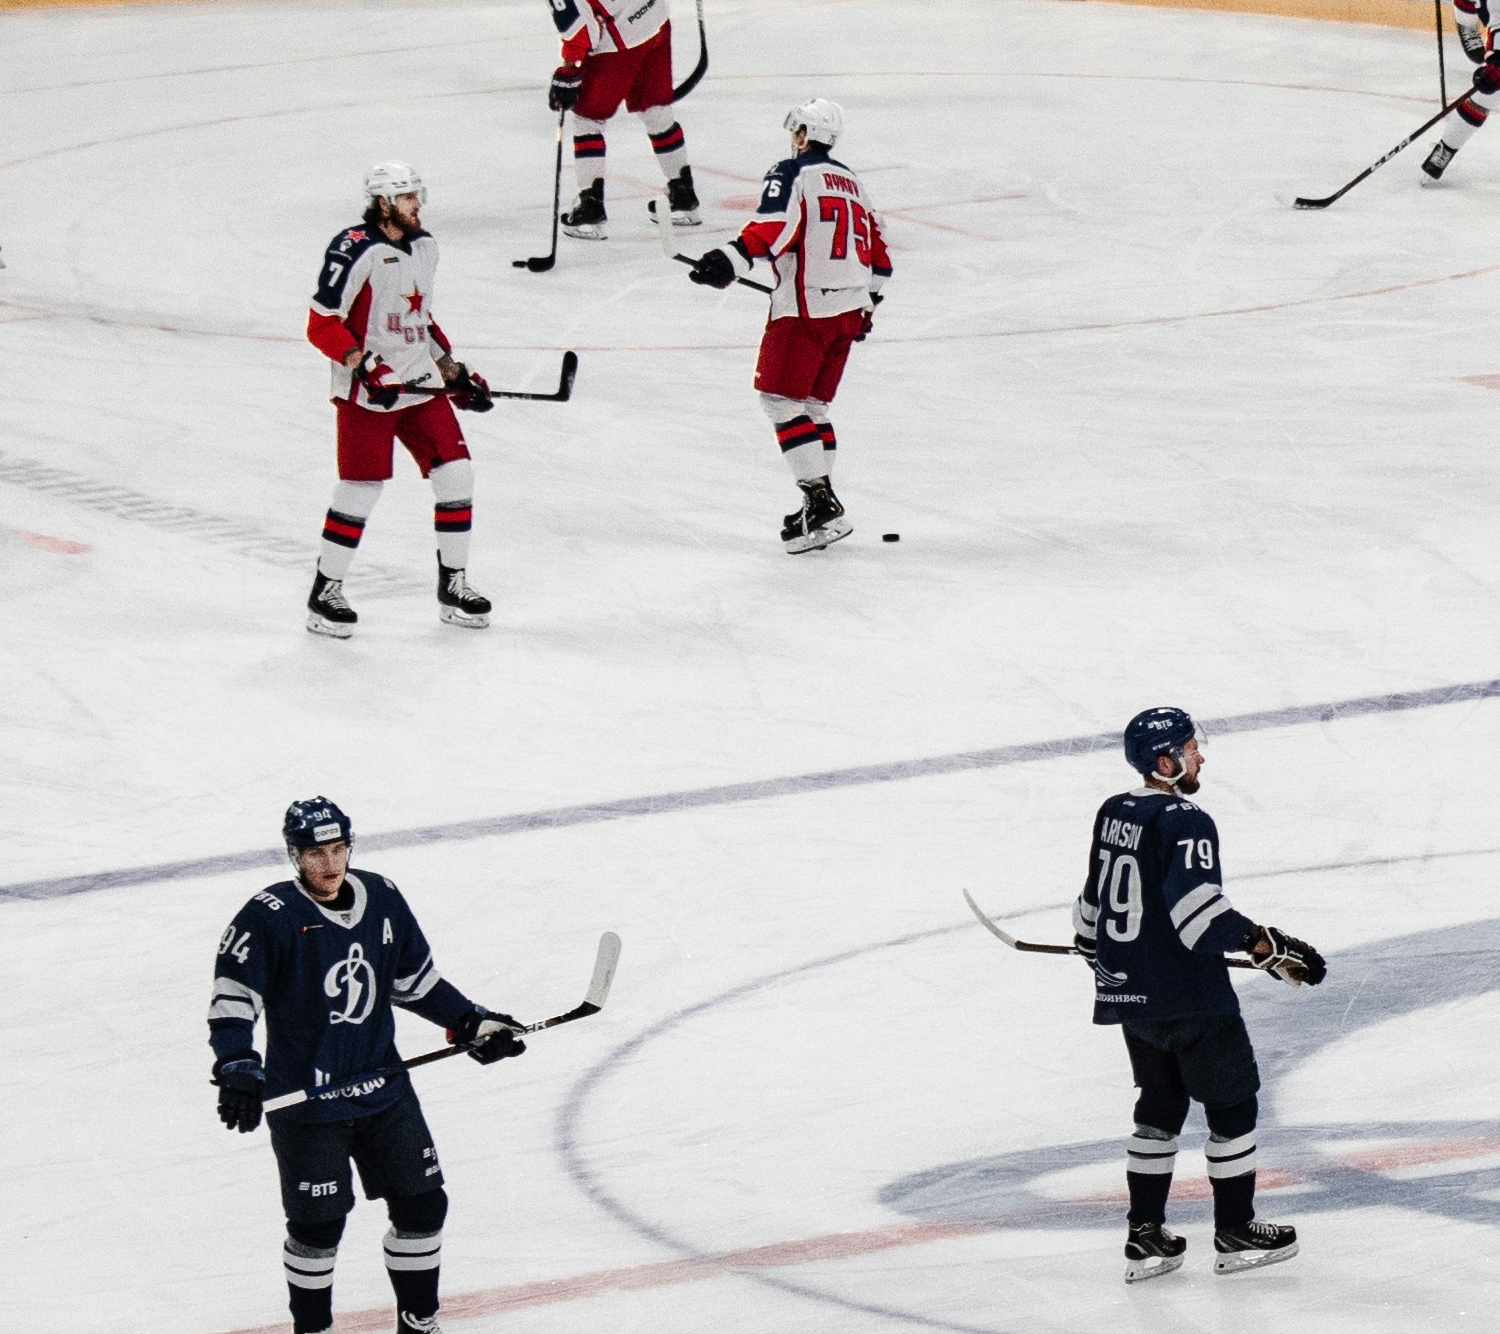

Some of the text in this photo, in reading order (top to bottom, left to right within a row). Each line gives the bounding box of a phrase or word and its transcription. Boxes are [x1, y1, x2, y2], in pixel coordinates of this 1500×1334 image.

[817, 195, 873, 268] 75
[387, 312, 426, 344] ЦСК
[1100, 816, 1143, 852] ARISOV
[1176, 838, 1213, 870] 79
[257, 890, 285, 912] ВТБ
[1097, 848, 1144, 942] 79
[217, 924, 251, 964] 94
[311, 1180, 338, 1198] ВТБ
